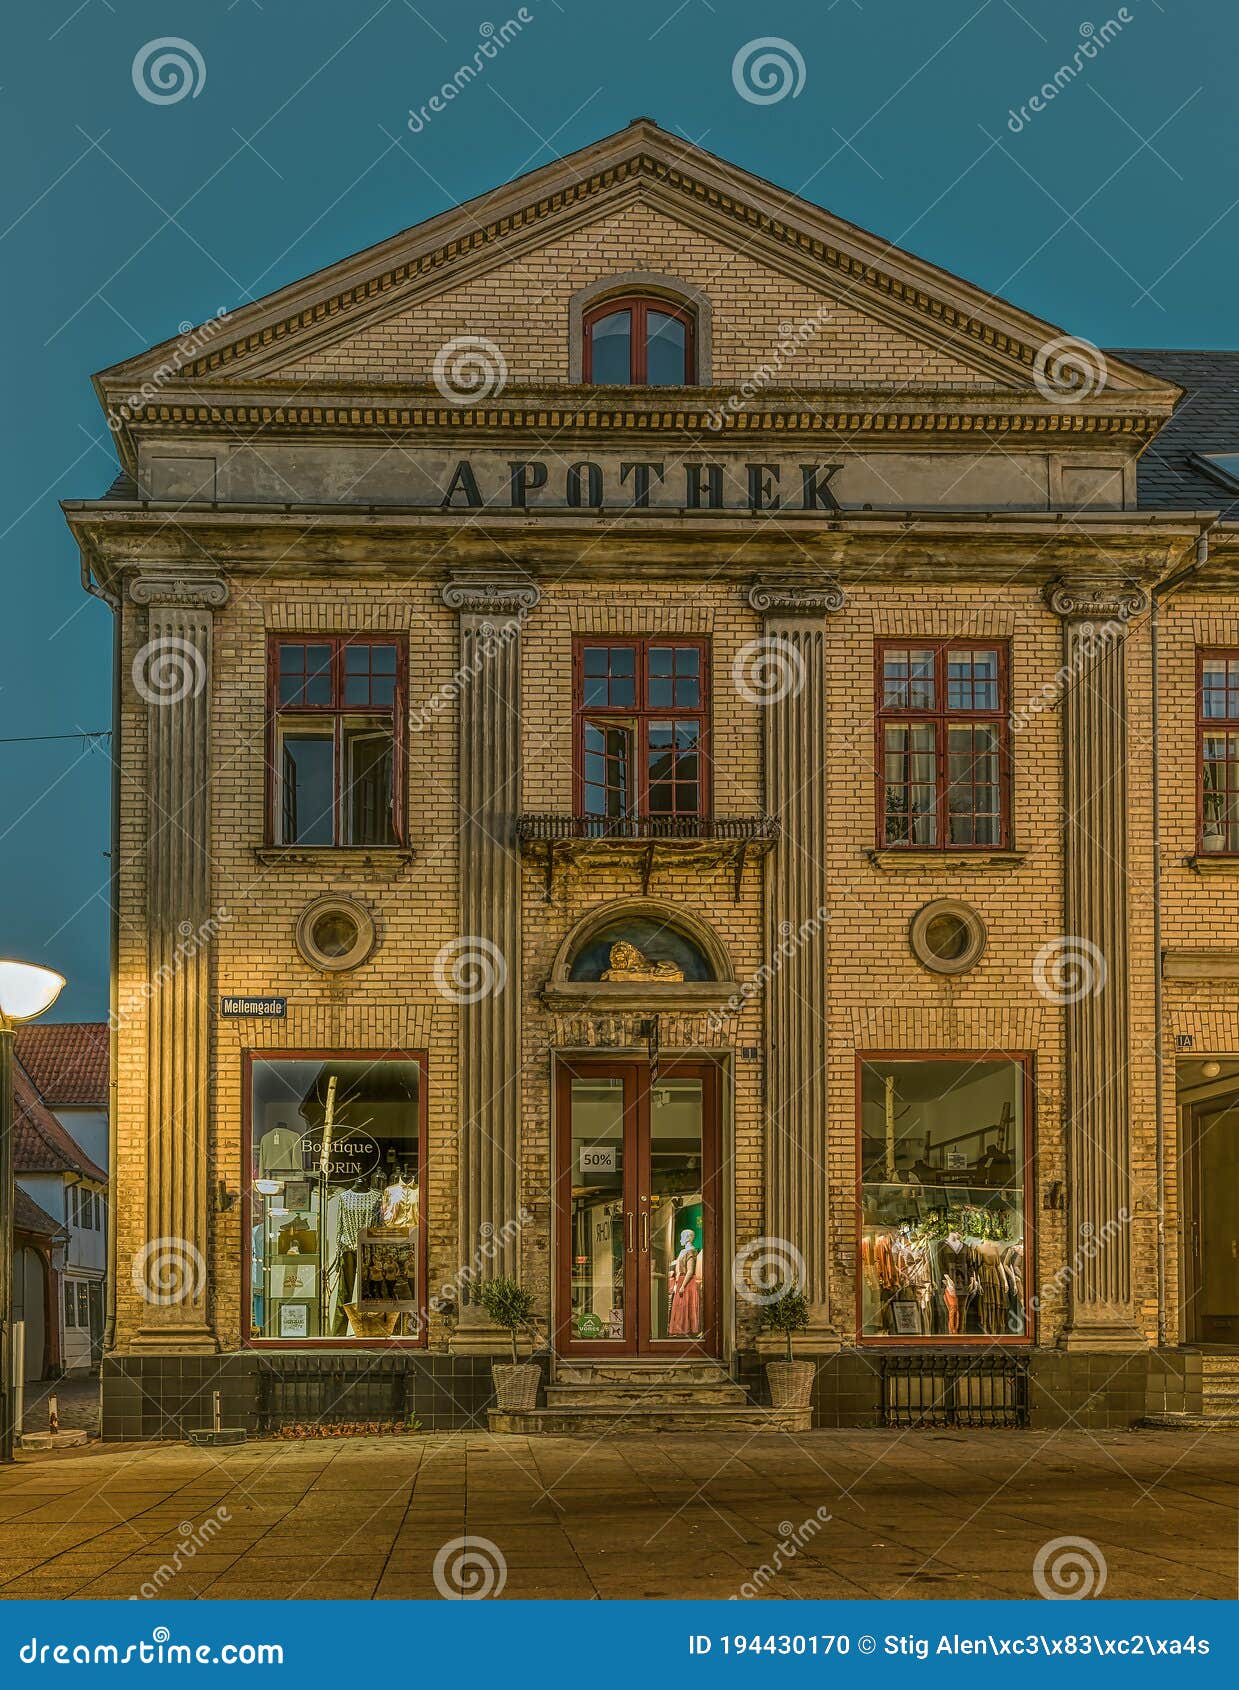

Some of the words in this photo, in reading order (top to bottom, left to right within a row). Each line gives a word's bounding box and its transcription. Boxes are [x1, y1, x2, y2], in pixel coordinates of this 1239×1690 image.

[224, 999, 282, 1015] Mellemgade
[1180, 1035, 1191, 1046] 1A
[300, 1139, 373, 1156] Boutique
[583, 1154, 612, 1166] 50%
[311, 1161, 360, 1174] DORIN
